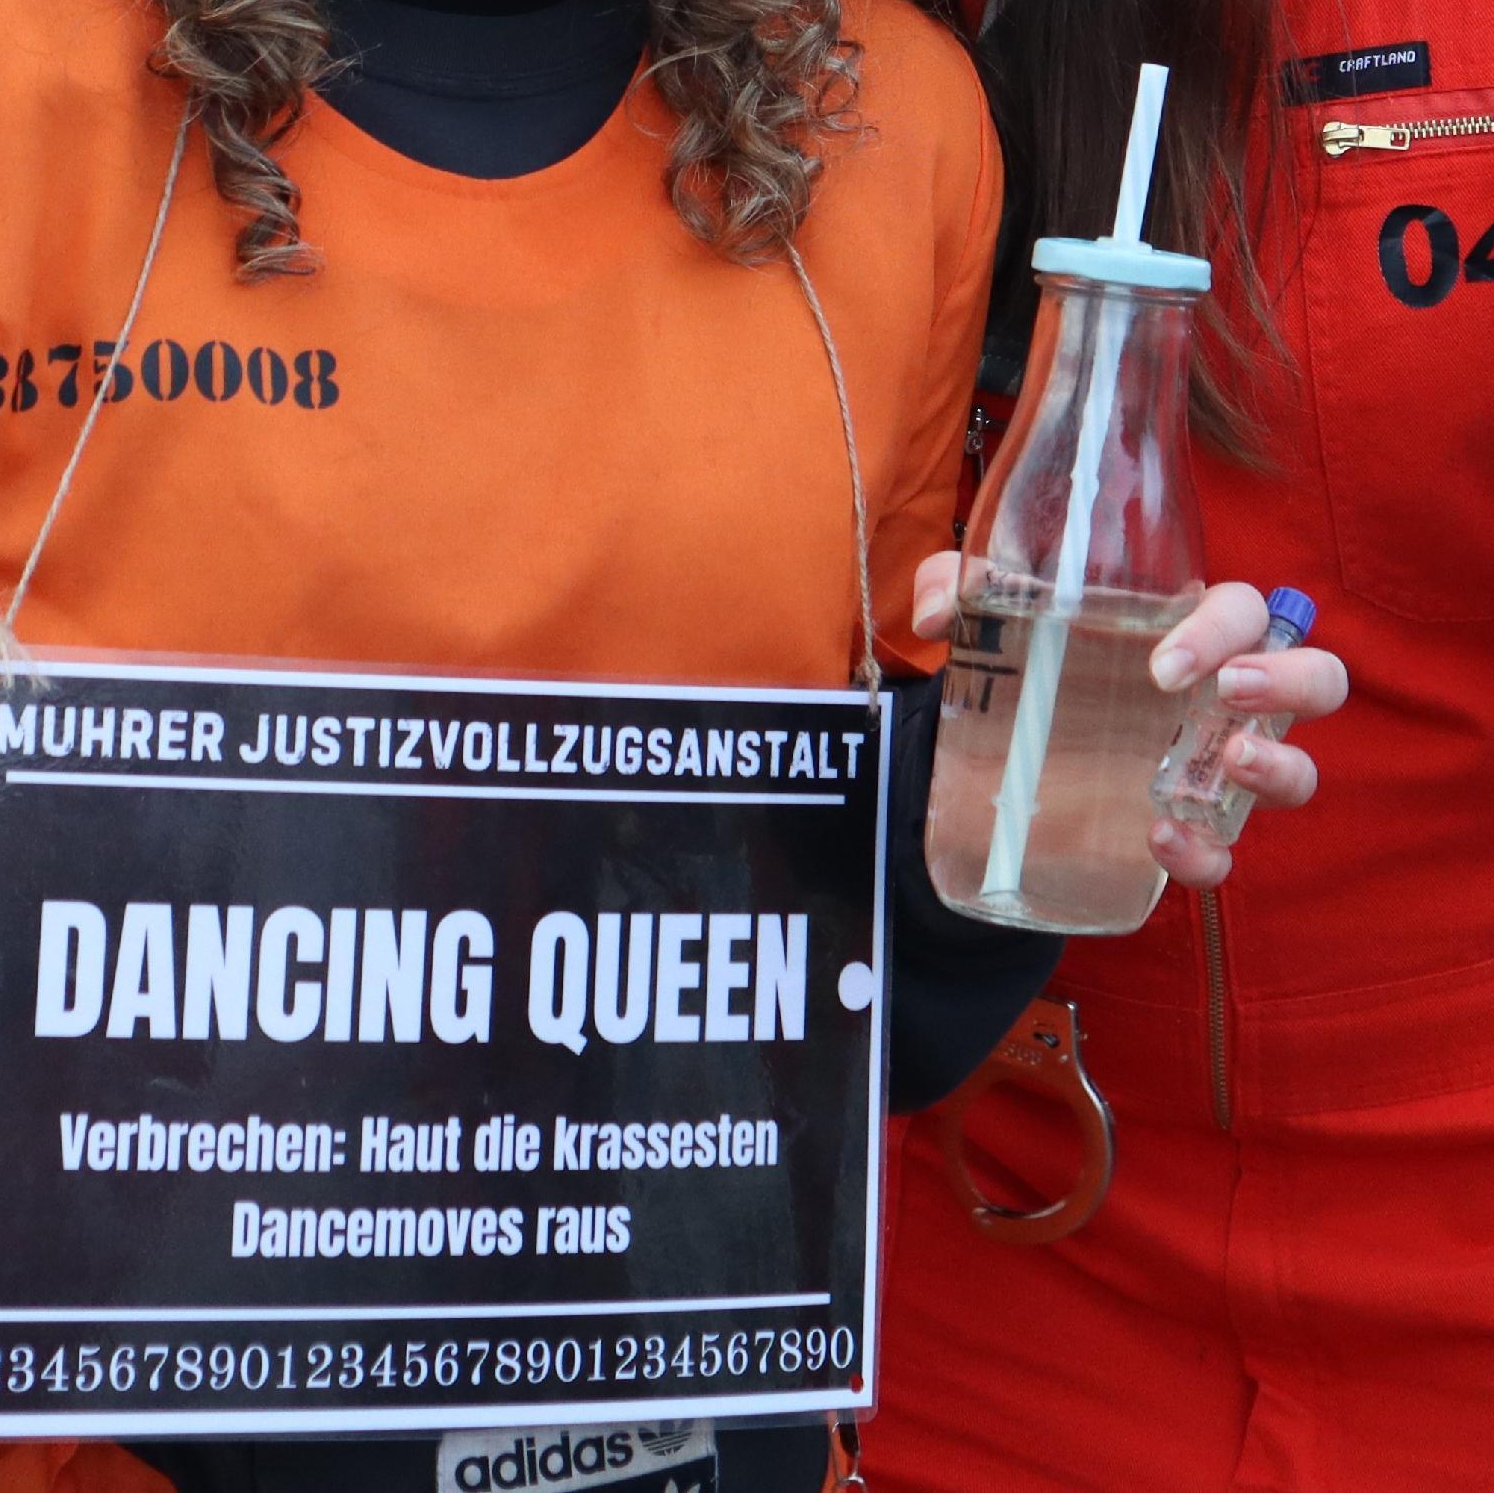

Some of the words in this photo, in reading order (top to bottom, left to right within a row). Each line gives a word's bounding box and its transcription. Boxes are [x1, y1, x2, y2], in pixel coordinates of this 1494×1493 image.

[1339, 50, 1416, 73] CRAFTLAND
[237, 712, 866, 780] JUSTIZVOLLZUGSANSTALT
[34, 900, 496, 1045] DANCING
[527, 911, 810, 1057] QUEEN
[59, 1113, 348, 1173] Verbrechen:
[359, 1116, 463, 1173] Haut
[472, 1113, 542, 1172] die
[552, 1118, 780, 1171] krassesten
[230, 1201, 525, 1259] Dancemoves
[535, 1205, 633, 1255] raus
[454, 1430, 634, 1493] adidas
